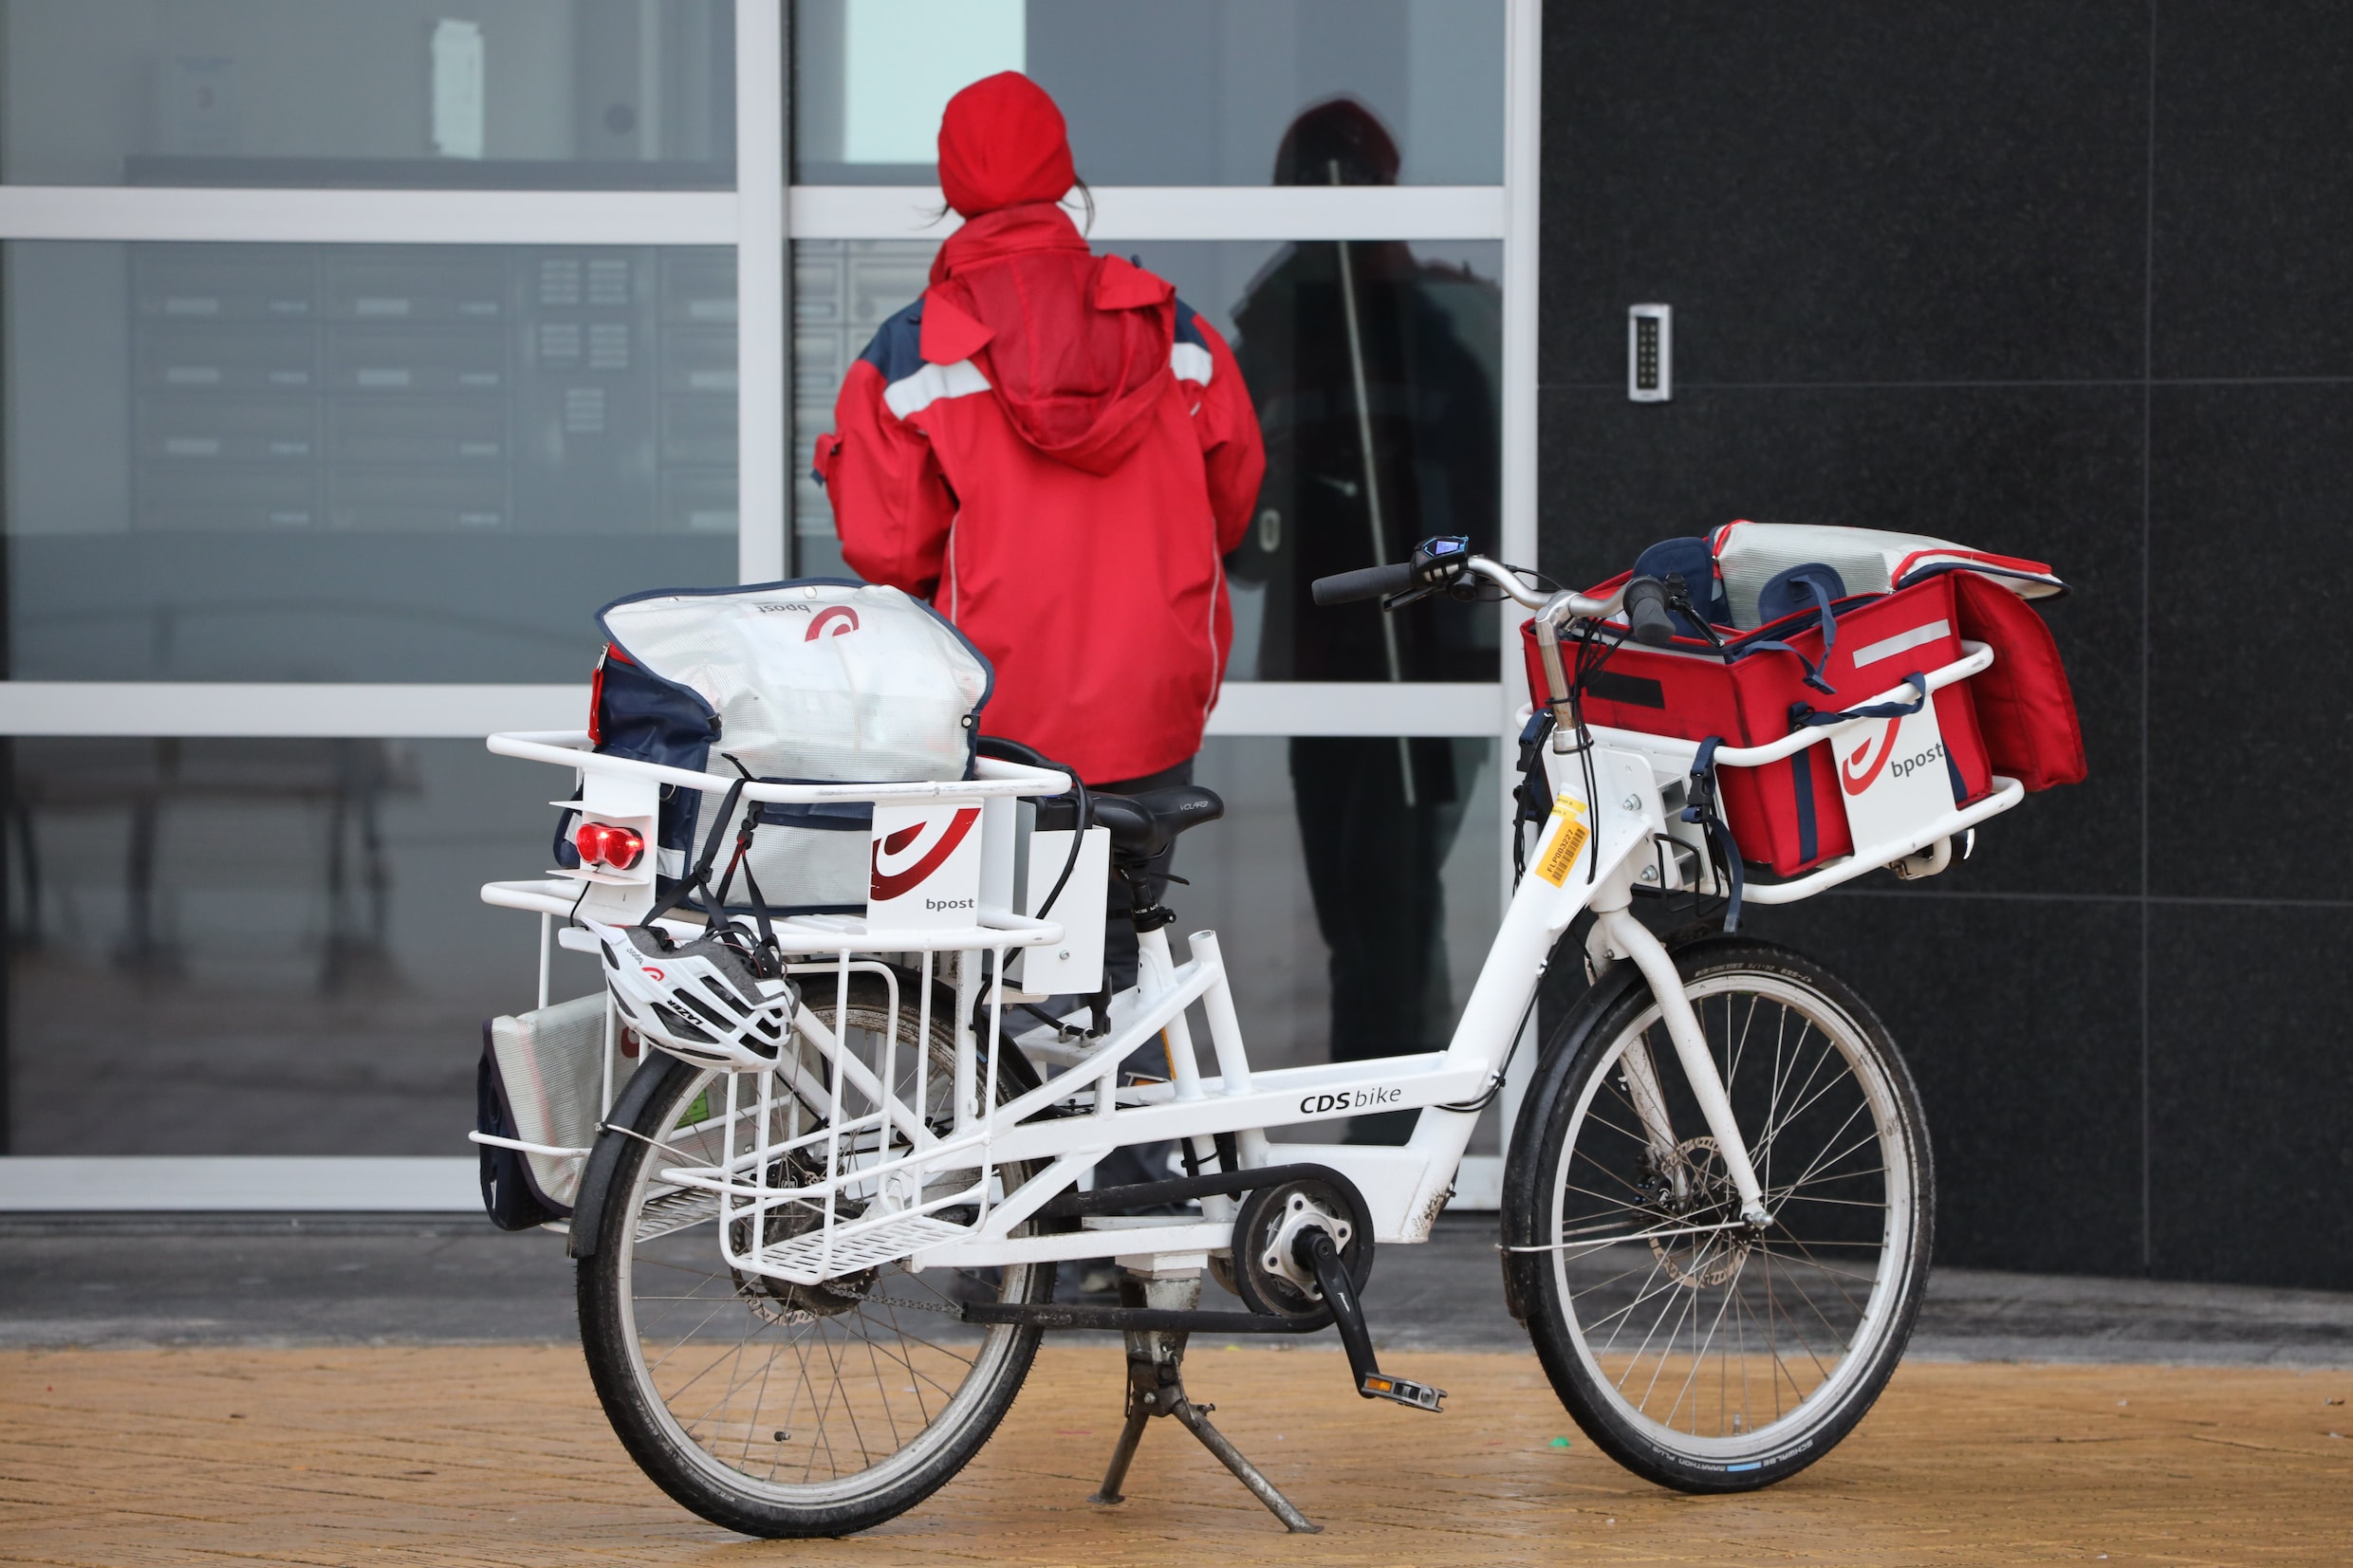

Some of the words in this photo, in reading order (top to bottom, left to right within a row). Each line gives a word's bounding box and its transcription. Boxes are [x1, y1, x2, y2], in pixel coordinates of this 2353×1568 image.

[758, 603, 811, 614] bpost
[1890, 742, 1944, 778] bpost
[1547, 828, 1574, 874] FLP003227
[926, 897, 974, 912] bpost
[666, 999, 704, 1025] LAZER
[1652, 1447, 1676, 1462] PLUS
[1763, 1439, 1814, 1467] SCHWALBE
